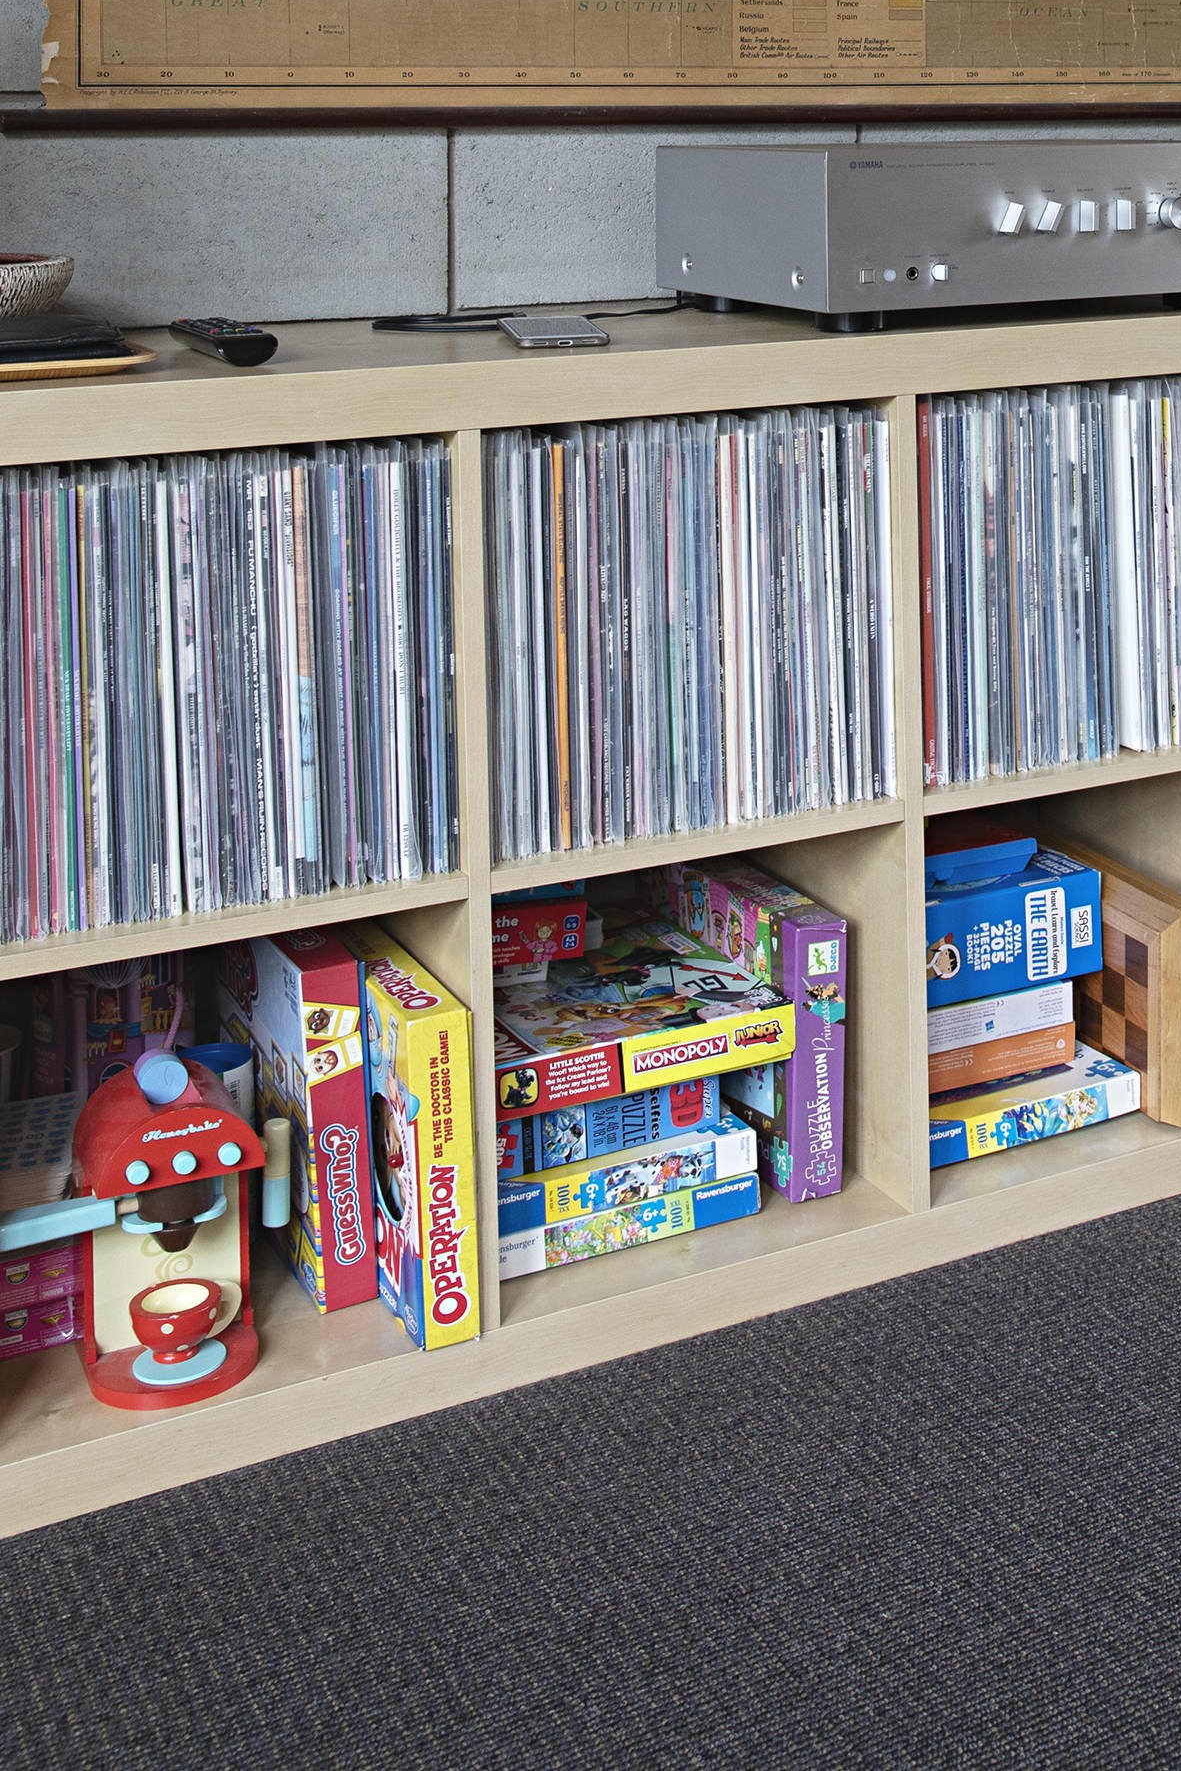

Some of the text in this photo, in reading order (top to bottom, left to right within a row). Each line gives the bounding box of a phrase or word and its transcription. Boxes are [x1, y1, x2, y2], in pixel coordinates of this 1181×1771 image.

[836, 13, 858, 21] Spain
[857, 161, 883, 169] YAMAHA
[245, 480, 252, 500] MR
[249, 558, 257, 615] MANCHU
[495, 916, 519, 928] the
[1030, 895, 1049, 977] THE EARTH
[1079, 910, 1089, 943] SASSI
[966, 934, 974, 965] BOOK!
[973, 933, 981, 971] 32-PAGE
[979, 922, 991, 972] PIECES
[990, 924, 1005, 964] 205
[1004, 920, 1014, 964] PUZZLE
[1013, 924, 1022, 956] OVAL
[830, 942, 838, 972] DJECO
[366, 956, 441, 1011] OPERATION
[735, 1021, 780, 1045] JUNIOR
[549, 1067, 568, 1077] Woof!
[569, 1063, 586, 1073] Which
[587, 1062, 599, 1072] way
[550, 1052, 606, 1070] LITTLE SCOTTIE
[635, 1038, 727, 1071] MONOPOLY
[440, 1030, 455, 1143] THIS CLASSIC GAME!
[546, 1065, 611, 1085] the Ice Cream Parlour?
[549, 1090, 566, 1100] you're
[568, 1087, 585, 1096] bound
[597, 1080, 609, 1089] win!
[551, 1083, 568, 1092] Follow
[570, 1081, 579, 1089] my
[581, 1076, 594, 1085] lead
[429, 1057, 443, 1158] BE THE DOCTOR IN
[650, 1088, 660, 1140] Selfies
[702, 1080, 715, 1118] Super
[807, 1053, 833, 1153] PUZZLE OBSERVATION
[593, 1110, 606, 1137] 24 18
[605, 1106, 619, 1144] 61 46 cm
[621, 1092, 646, 1147] PUZZLE
[976, 1123, 988, 1144] 100
[1000, 1123, 1012, 1138] 6+
[817, 1160, 825, 1175] 54
[498, 1188, 541, 1206] ensburger
[558, 1184, 570, 1205] 100
[585, 1184, 599, 1200] 6+
[695, 1179, 753, 1201] Ravensburger
[643, 1207, 658, 1221] 6+
[670, 1206, 684, 1229] 100
[430, 1165, 468, 1324] OPERATION
